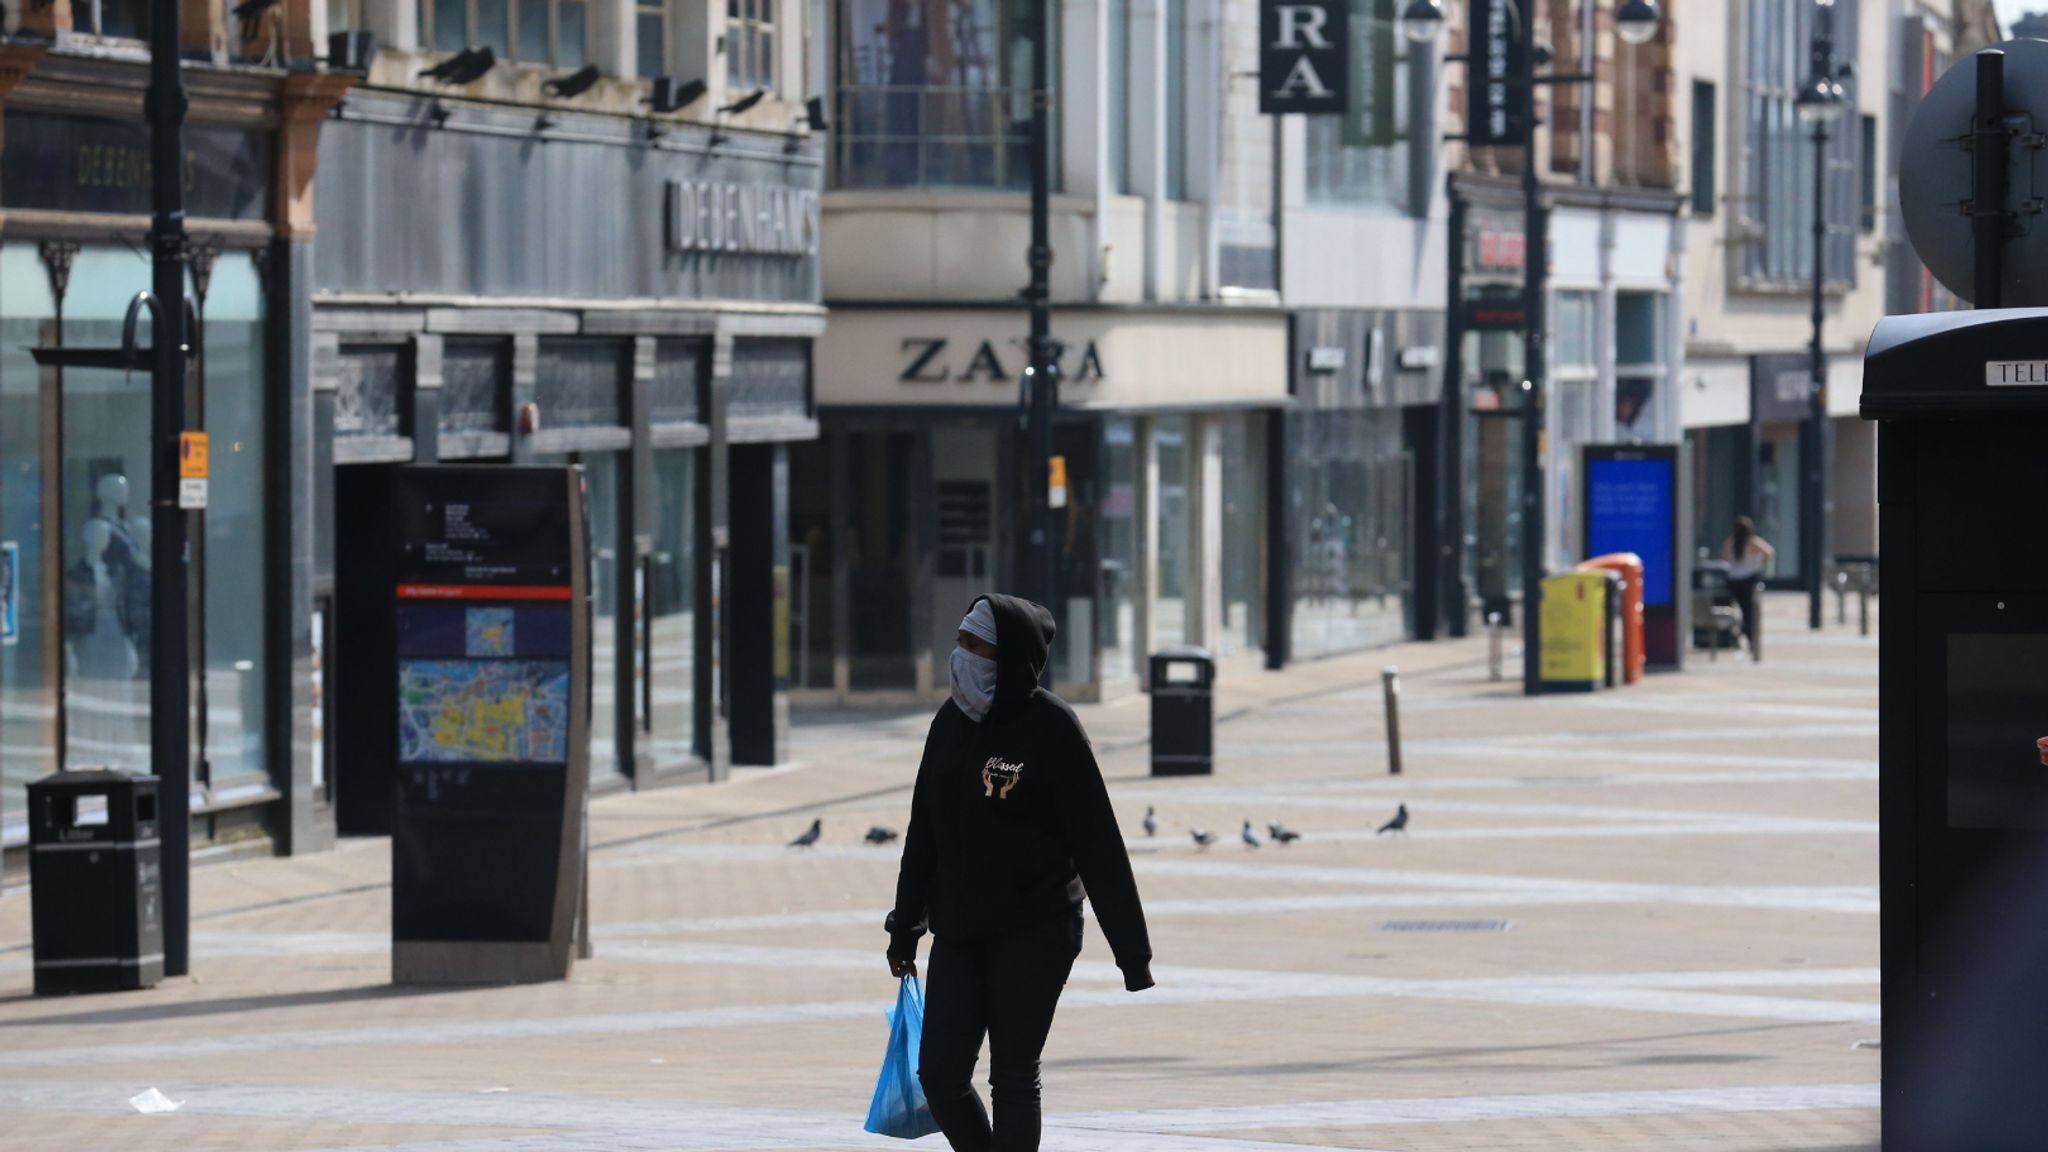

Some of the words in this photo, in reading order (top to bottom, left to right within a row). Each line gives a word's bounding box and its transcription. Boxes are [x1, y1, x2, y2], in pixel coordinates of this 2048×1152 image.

[78, 145, 197, 191] DEBENHS
[679, 180, 818, 256] DEBENHAMS
[1997, 363, 2048, 383] TEL
[984, 756, 1024, 773] Blessed
